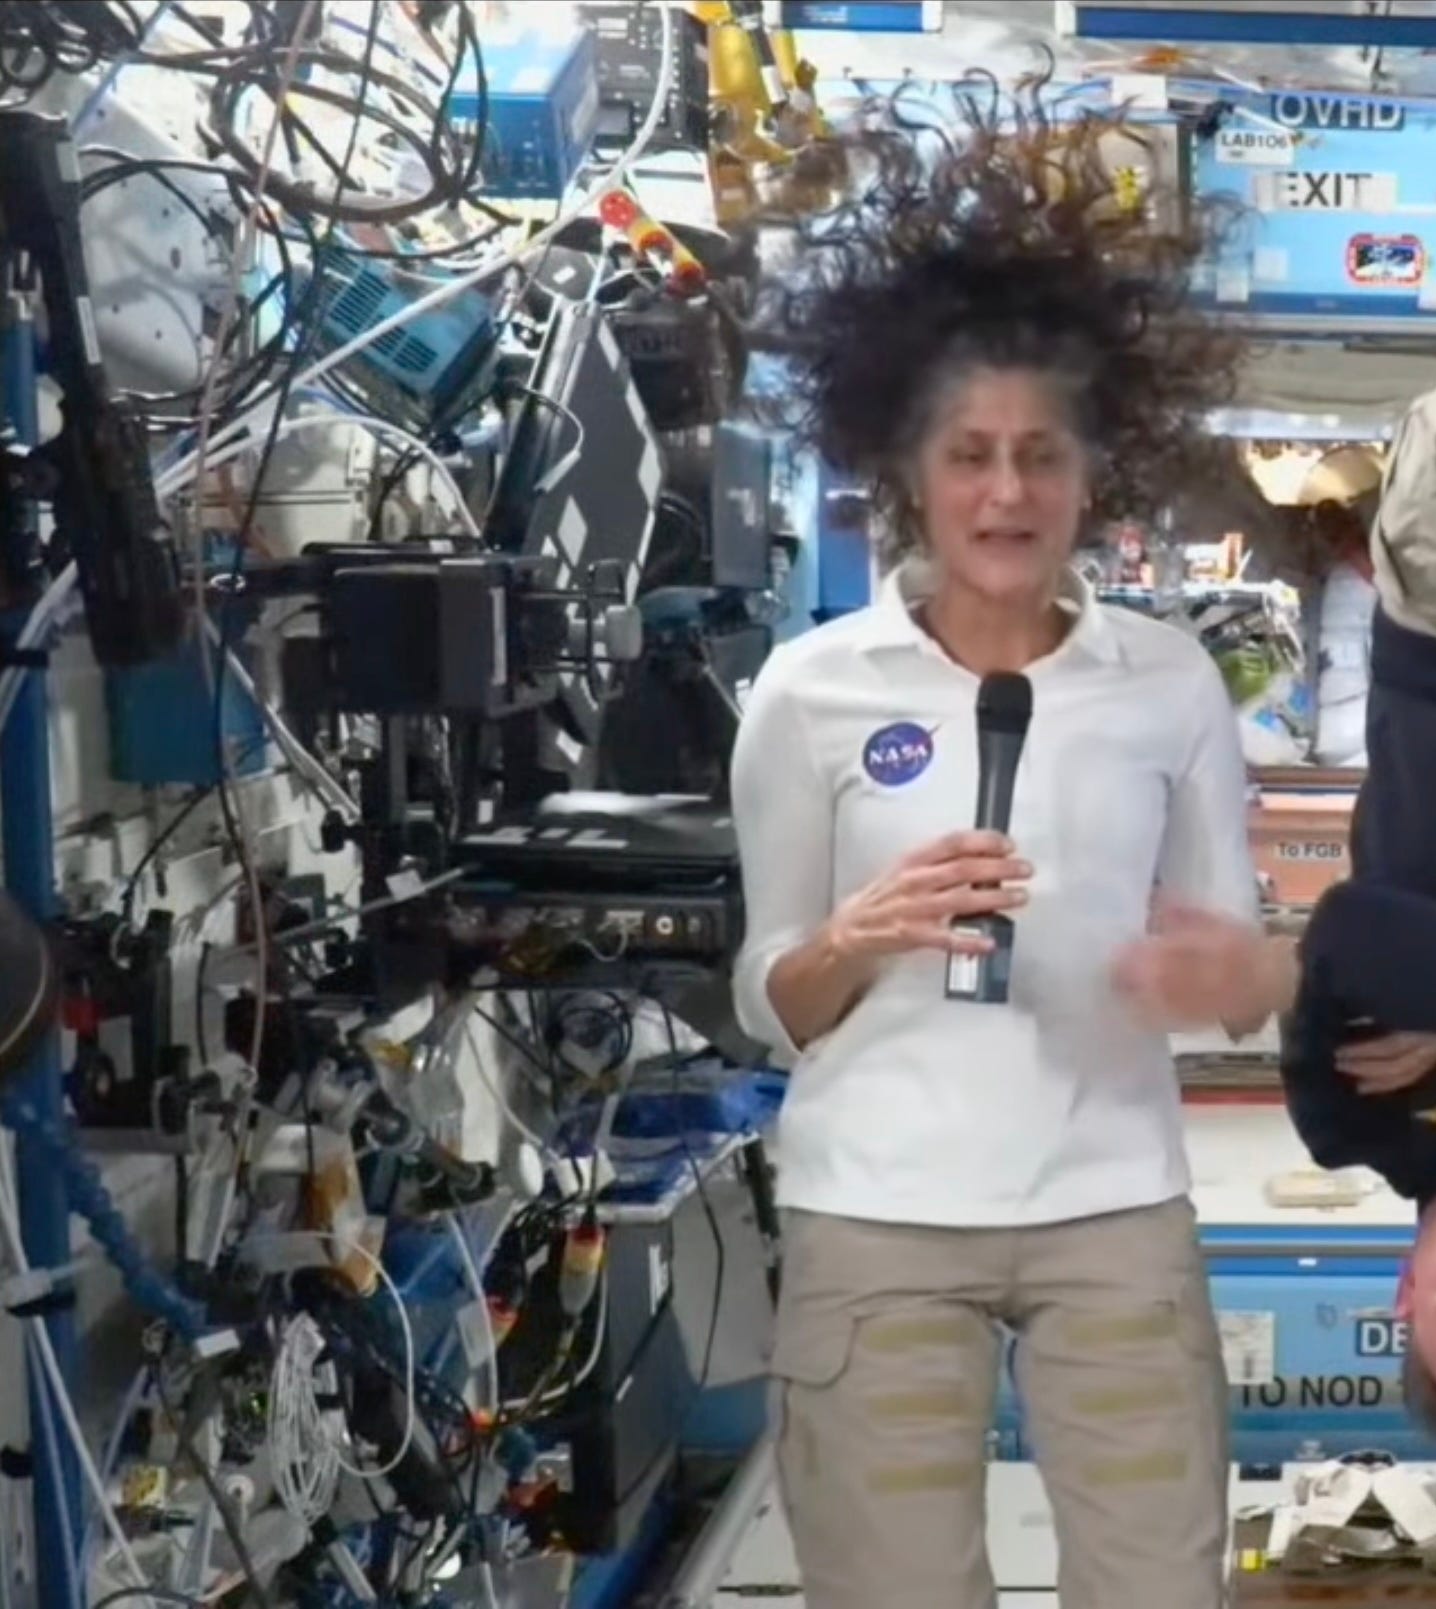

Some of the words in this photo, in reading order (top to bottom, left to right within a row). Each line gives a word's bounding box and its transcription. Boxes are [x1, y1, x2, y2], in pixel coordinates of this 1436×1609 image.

[1275, 96, 1402, 129] OVHD
[1274, 172, 1372, 207] EXIT
[868, 744, 929, 766] NASA
[1279, 842, 1299, 857] To
[1304, 843, 1342, 858] FGB
[1301, 1376, 1383, 1407] NOD
